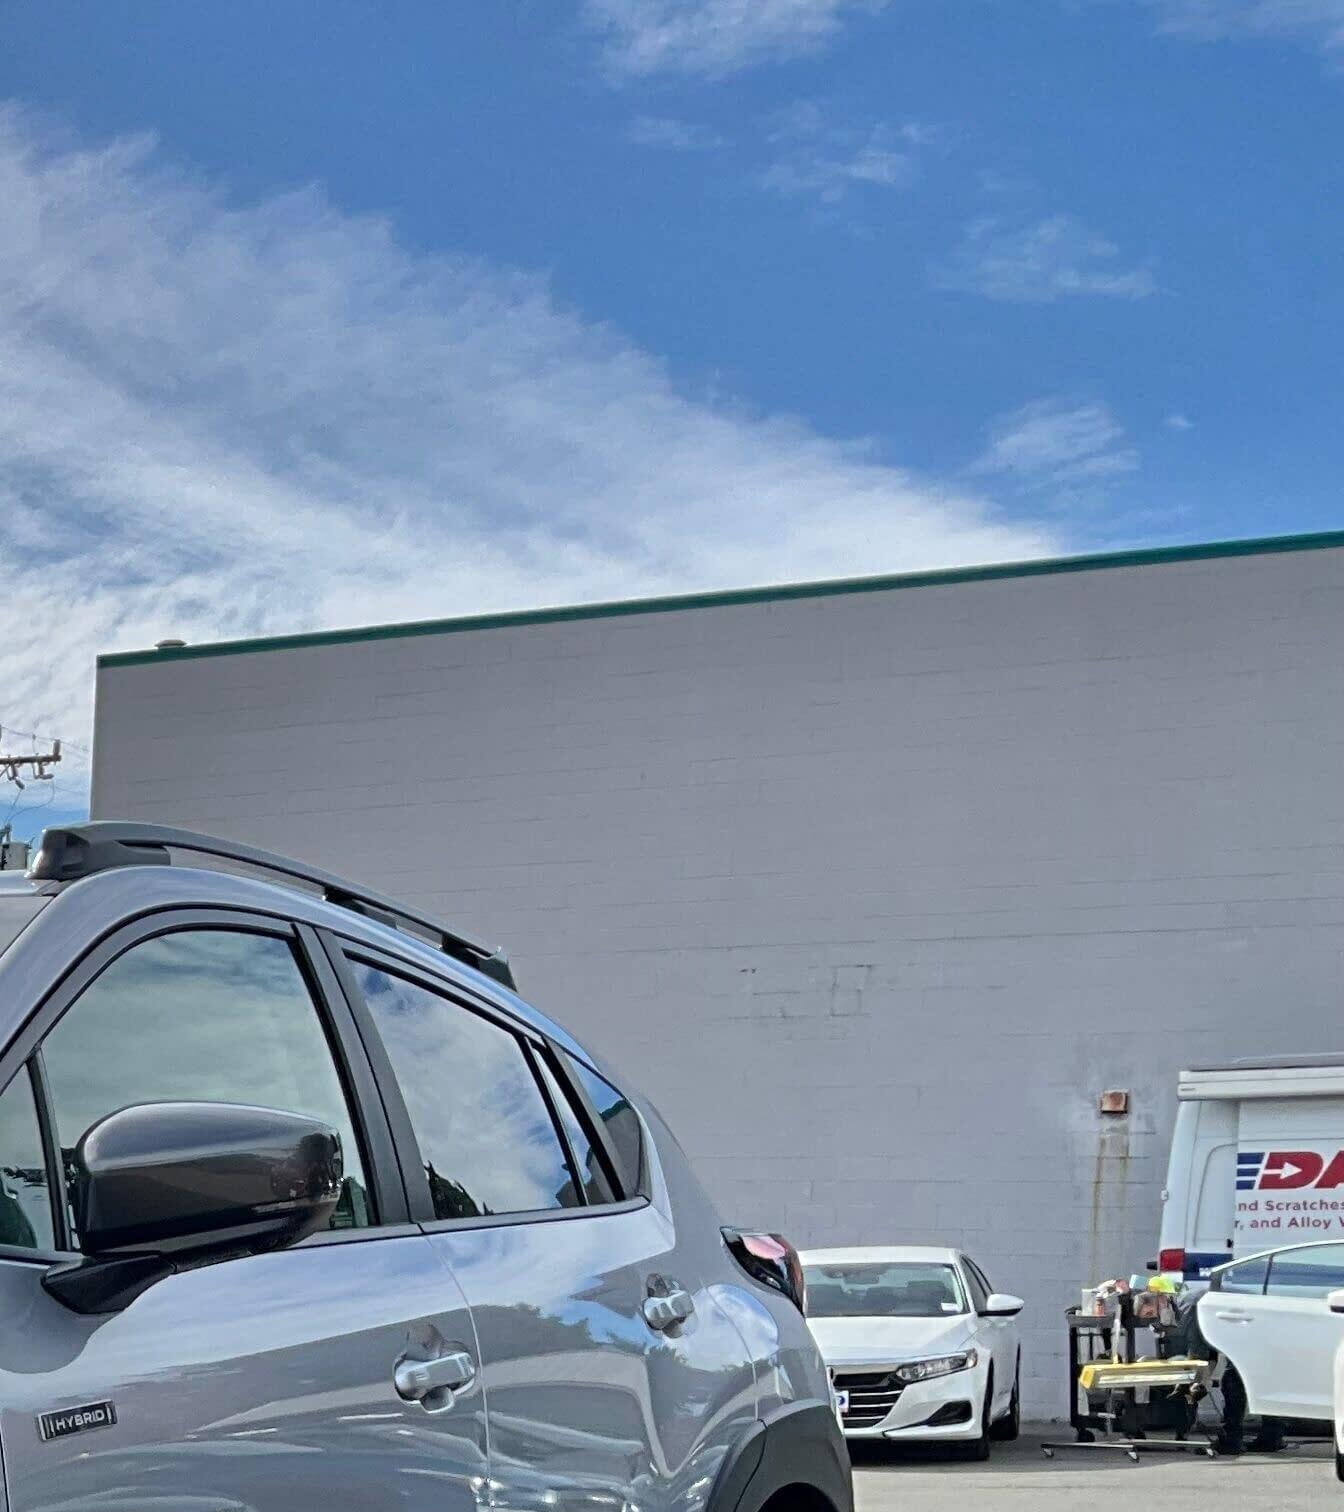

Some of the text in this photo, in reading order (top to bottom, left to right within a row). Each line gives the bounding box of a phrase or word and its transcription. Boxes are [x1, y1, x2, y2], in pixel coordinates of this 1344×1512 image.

[1250, 1217, 1281, 1229] and
[1287, 1216, 1332, 1230] Alloy
[55, 1409, 105, 1431] HYBRID
